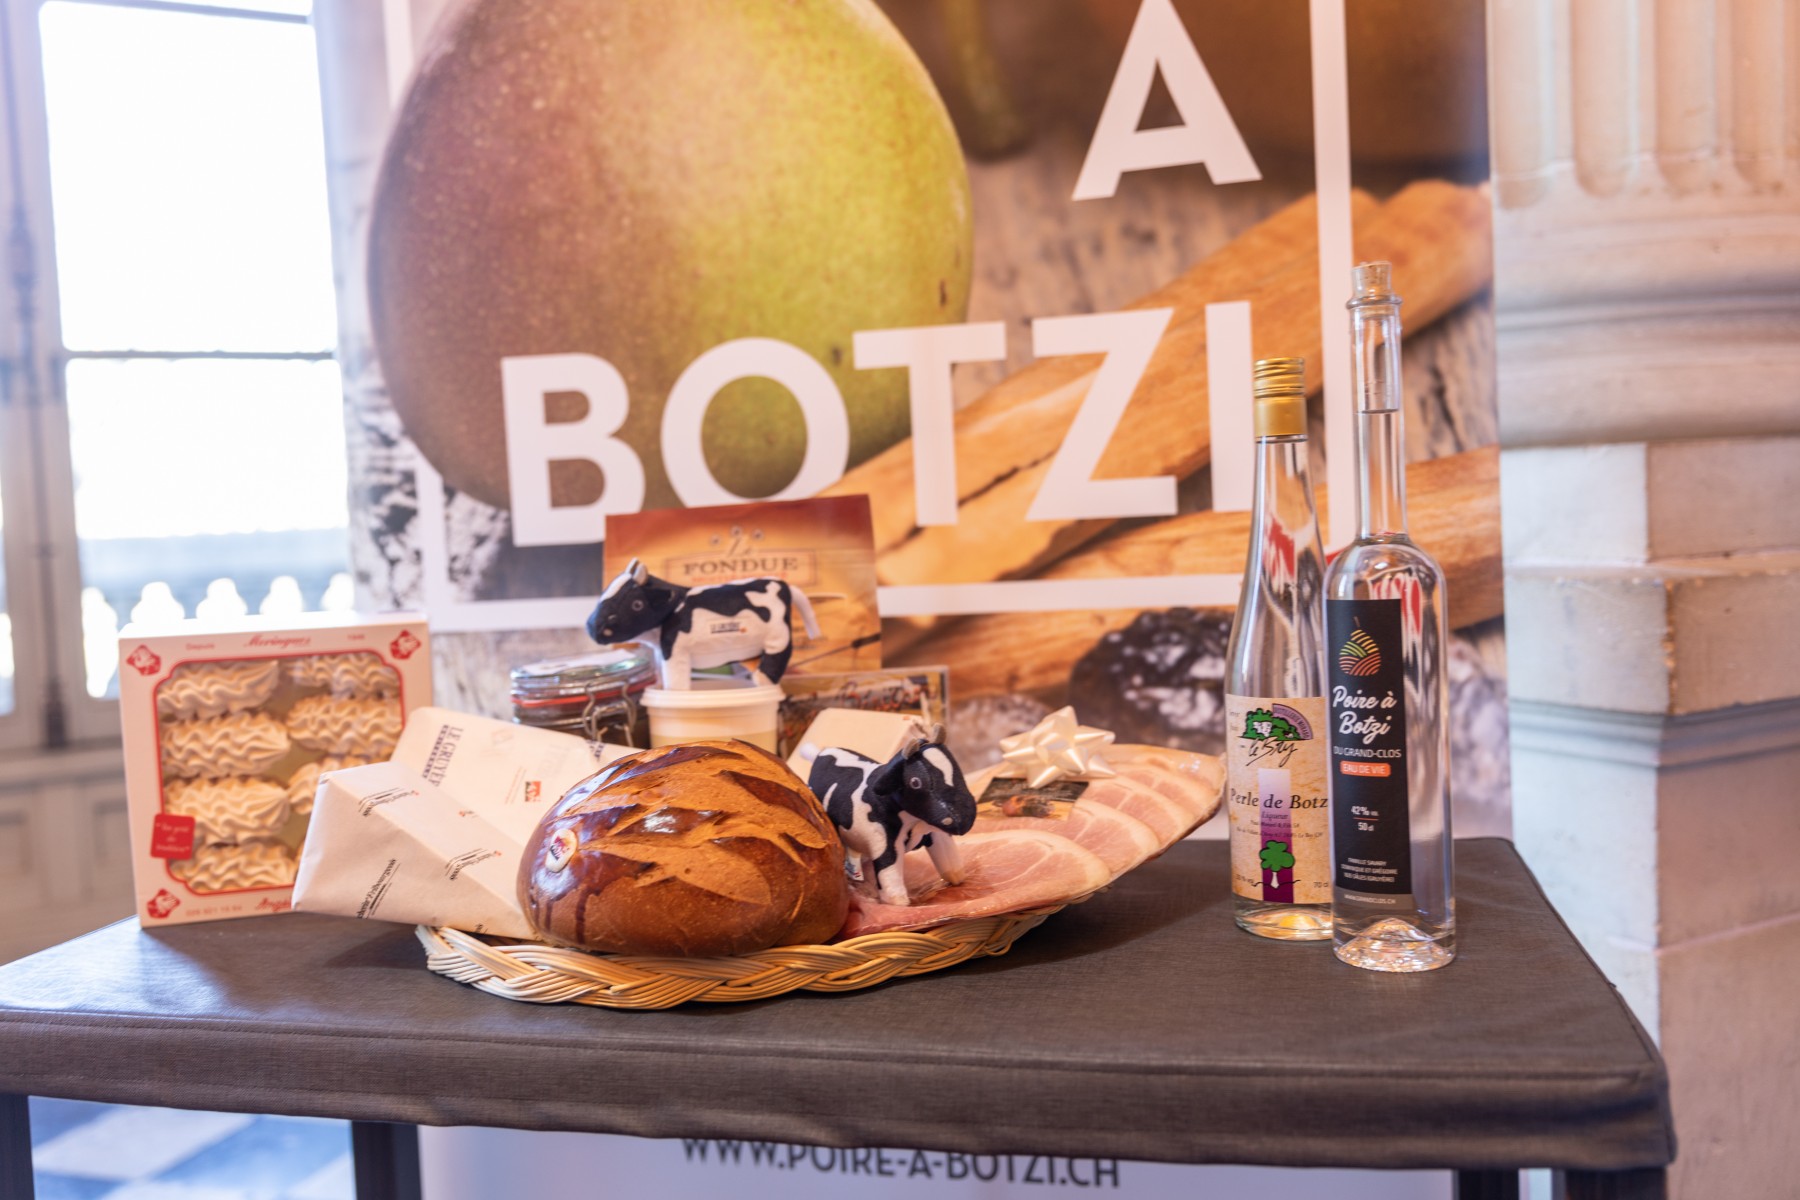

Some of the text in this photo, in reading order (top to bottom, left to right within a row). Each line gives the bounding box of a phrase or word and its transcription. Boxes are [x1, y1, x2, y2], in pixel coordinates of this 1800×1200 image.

[1071, 0, 1263, 201] A
[501, 301, 1254, 548] BOTZI
[683, 558, 798, 575] FONDUE
[243, 634, 311, 648] Meringues
[1332, 685, 1397, 709] Poire à
[1339, 710, 1391, 745] Botzi
[1343, 747, 1402, 758] GRAND-CLOS
[1343, 763, 1386, 774] EAU DE VIE
[1230, 787, 1329, 809] Perle de Botz
[681, 1138, 1120, 1189] WWW.POIRE-A-BOTZI.CH
